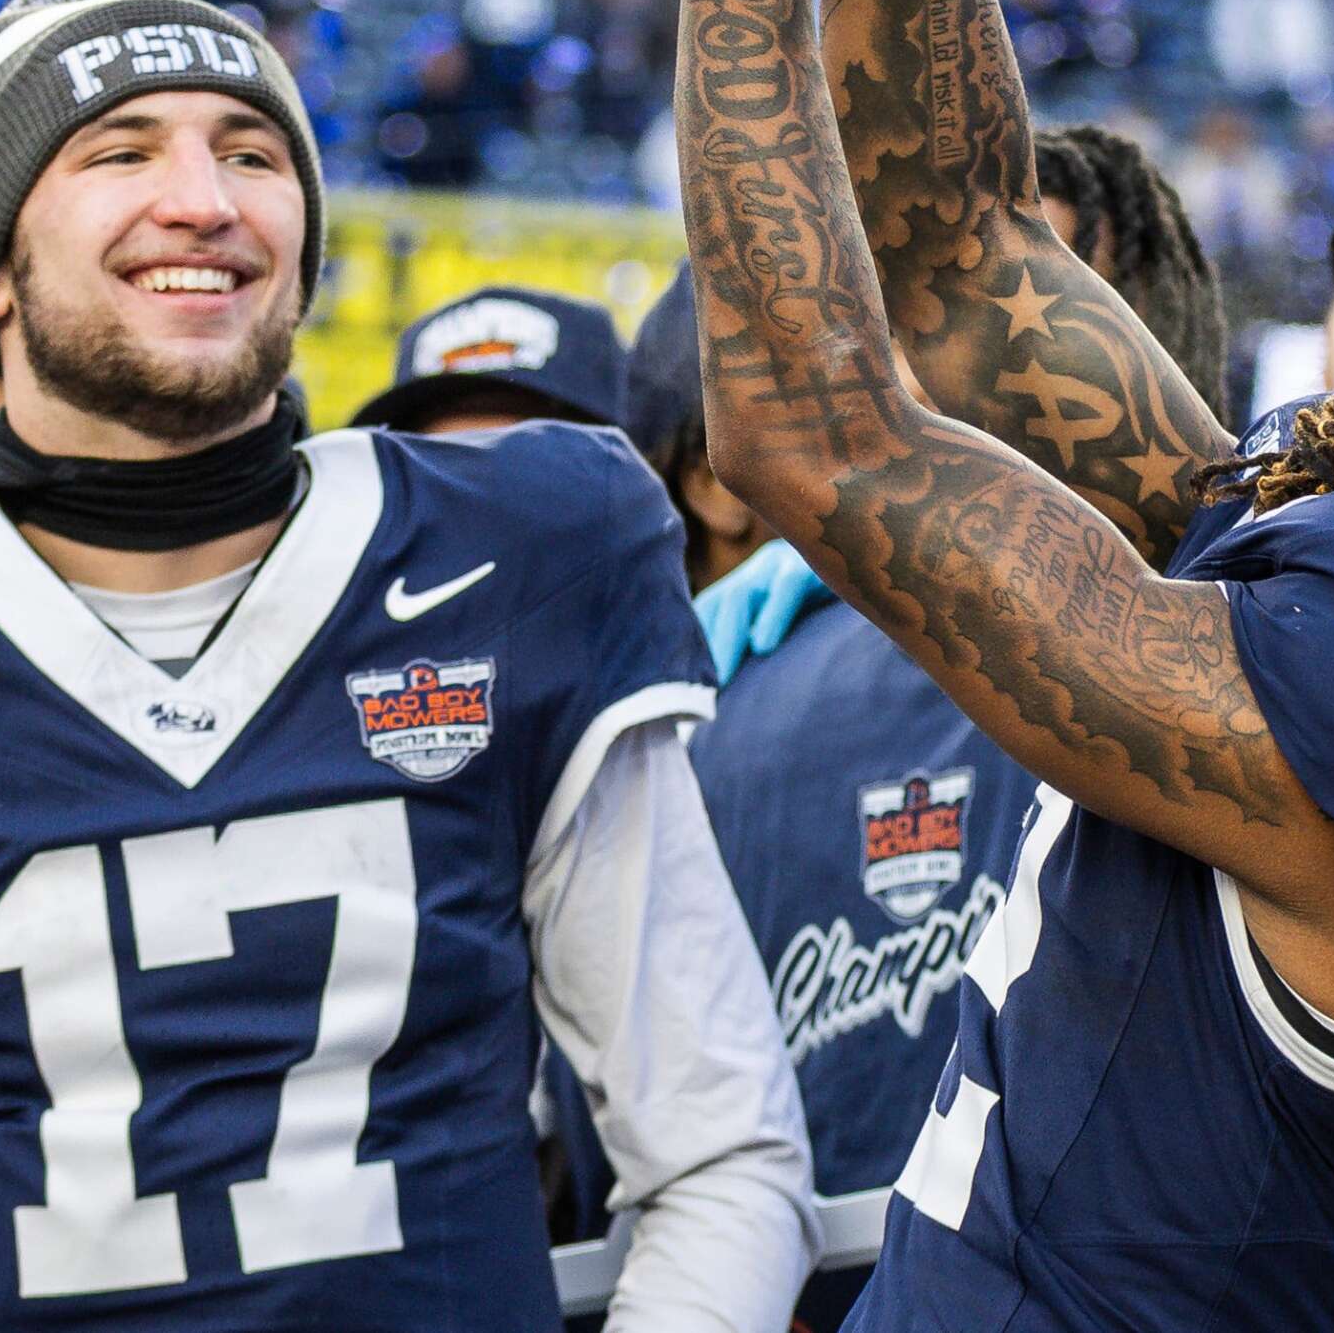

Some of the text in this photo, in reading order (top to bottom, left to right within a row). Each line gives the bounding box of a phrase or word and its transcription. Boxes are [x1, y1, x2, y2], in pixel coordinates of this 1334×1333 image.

[57, 23, 258, 104] PSU
[363, 687, 482, 714] BAD BOY
[365, 703, 486, 731] MOWERS
